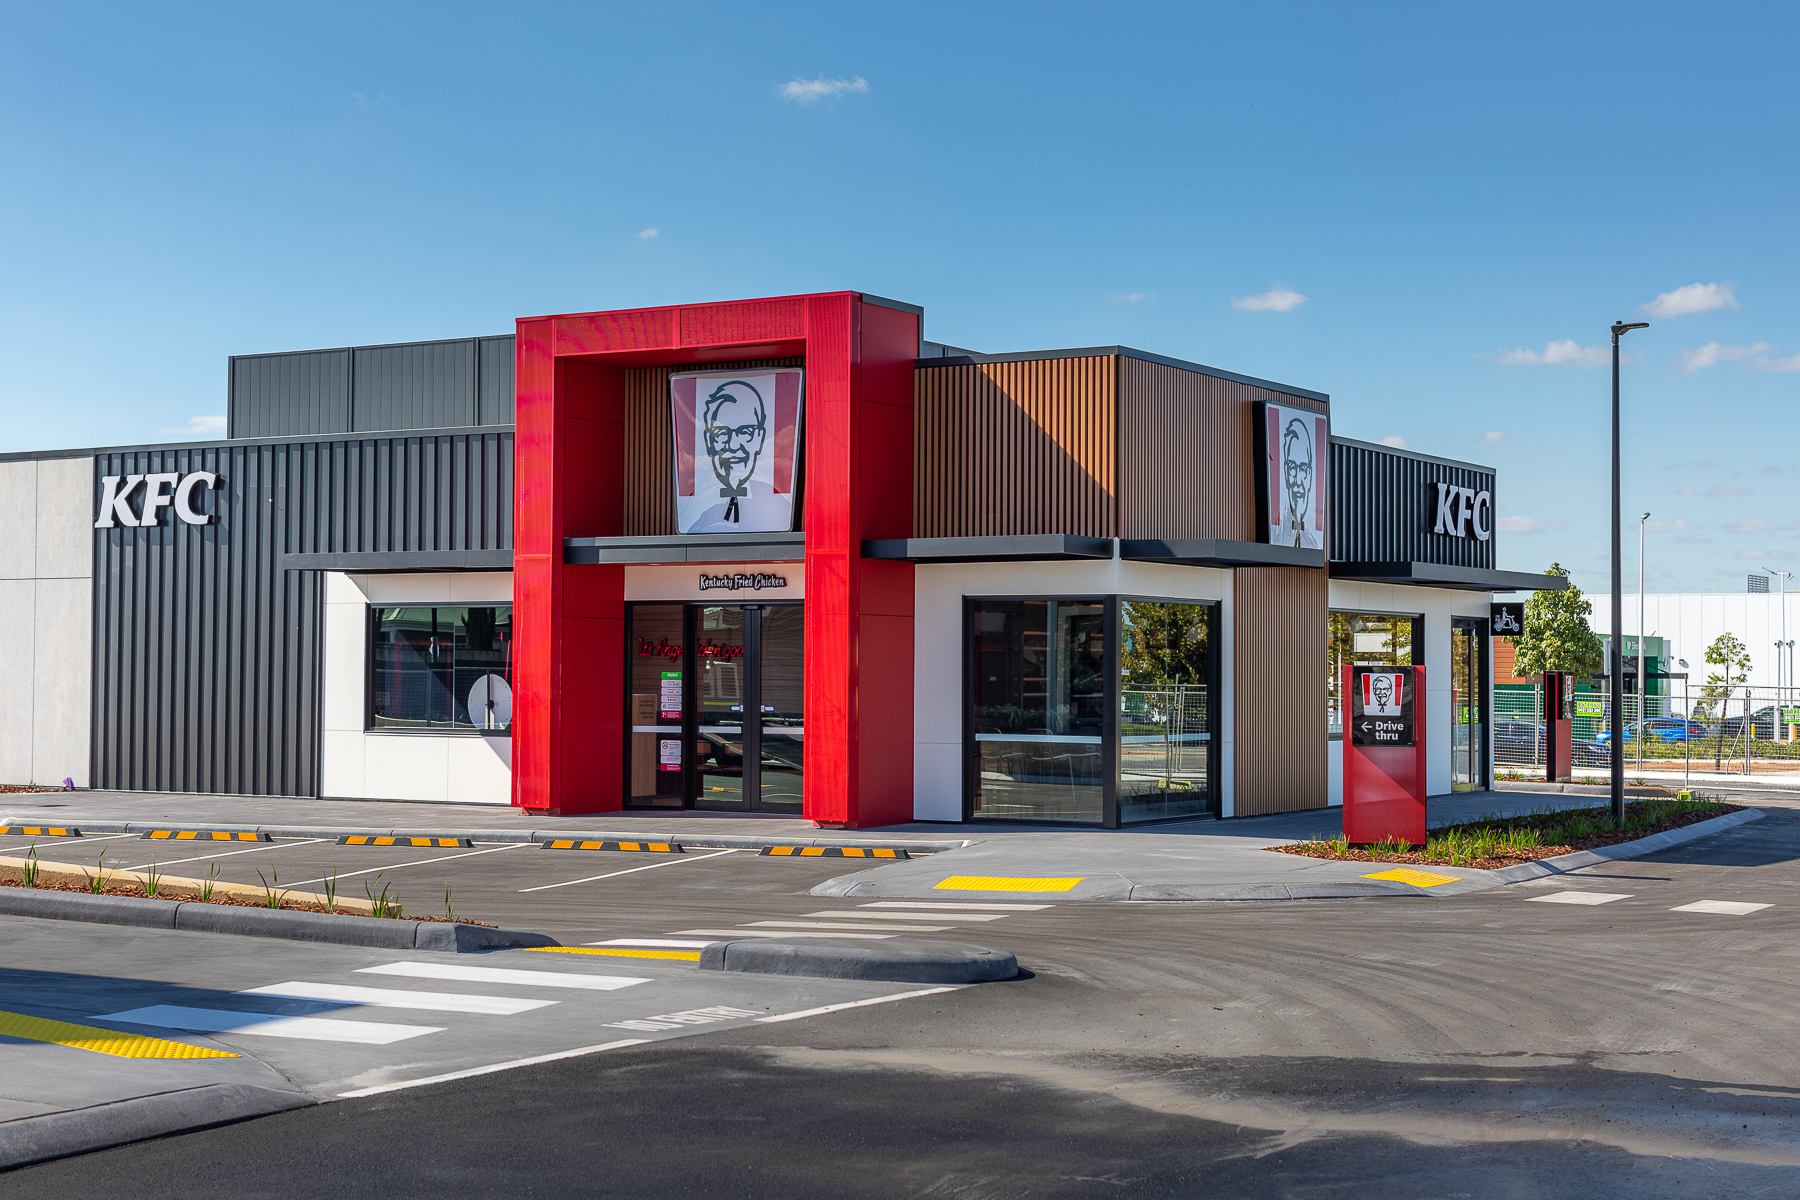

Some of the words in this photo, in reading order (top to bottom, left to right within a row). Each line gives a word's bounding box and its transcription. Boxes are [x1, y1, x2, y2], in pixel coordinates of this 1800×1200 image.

[94, 470, 217, 528] KFC
[1434, 482, 1490, 541] KFC
[700, 575, 733, 590] Kentucky
[734, 575, 753, 589] Fried
[754, 574, 784, 590] Chicken
[655, 637, 684, 663] finge
[721, 645, 744, 663] goo
[1375, 721, 1404, 730] Drive
[1375, 731, 1398, 740] thru
